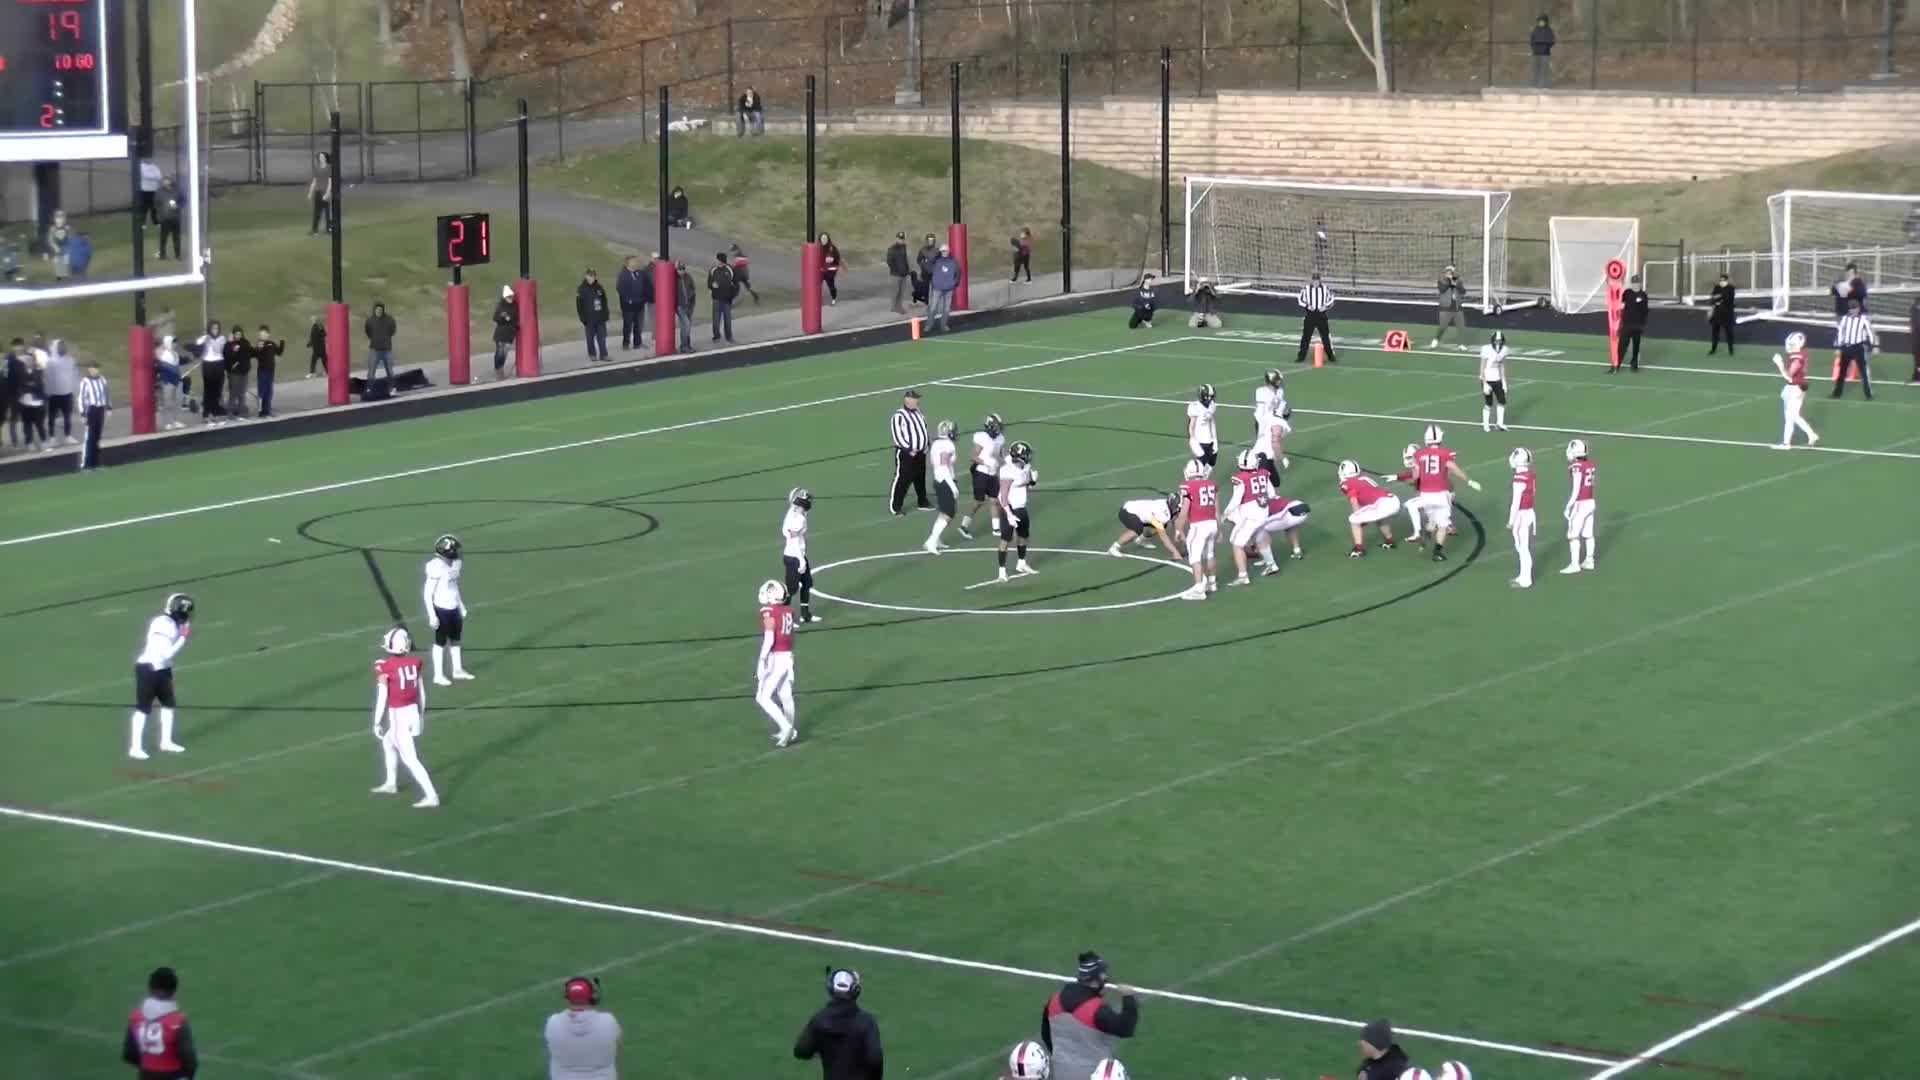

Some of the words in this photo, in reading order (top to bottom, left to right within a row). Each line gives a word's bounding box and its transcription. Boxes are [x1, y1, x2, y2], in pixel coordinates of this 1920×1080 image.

[49, 11, 80, 40] 19
[40, 104, 55, 128] 2
[449, 220, 487, 262] 21
[1387, 331, 1403, 348] G
[1420, 454, 1440, 474] 73
[1199, 485, 1216, 506] 65
[398, 664, 418, 690] 14
[138, 1021, 165, 1054] 19
